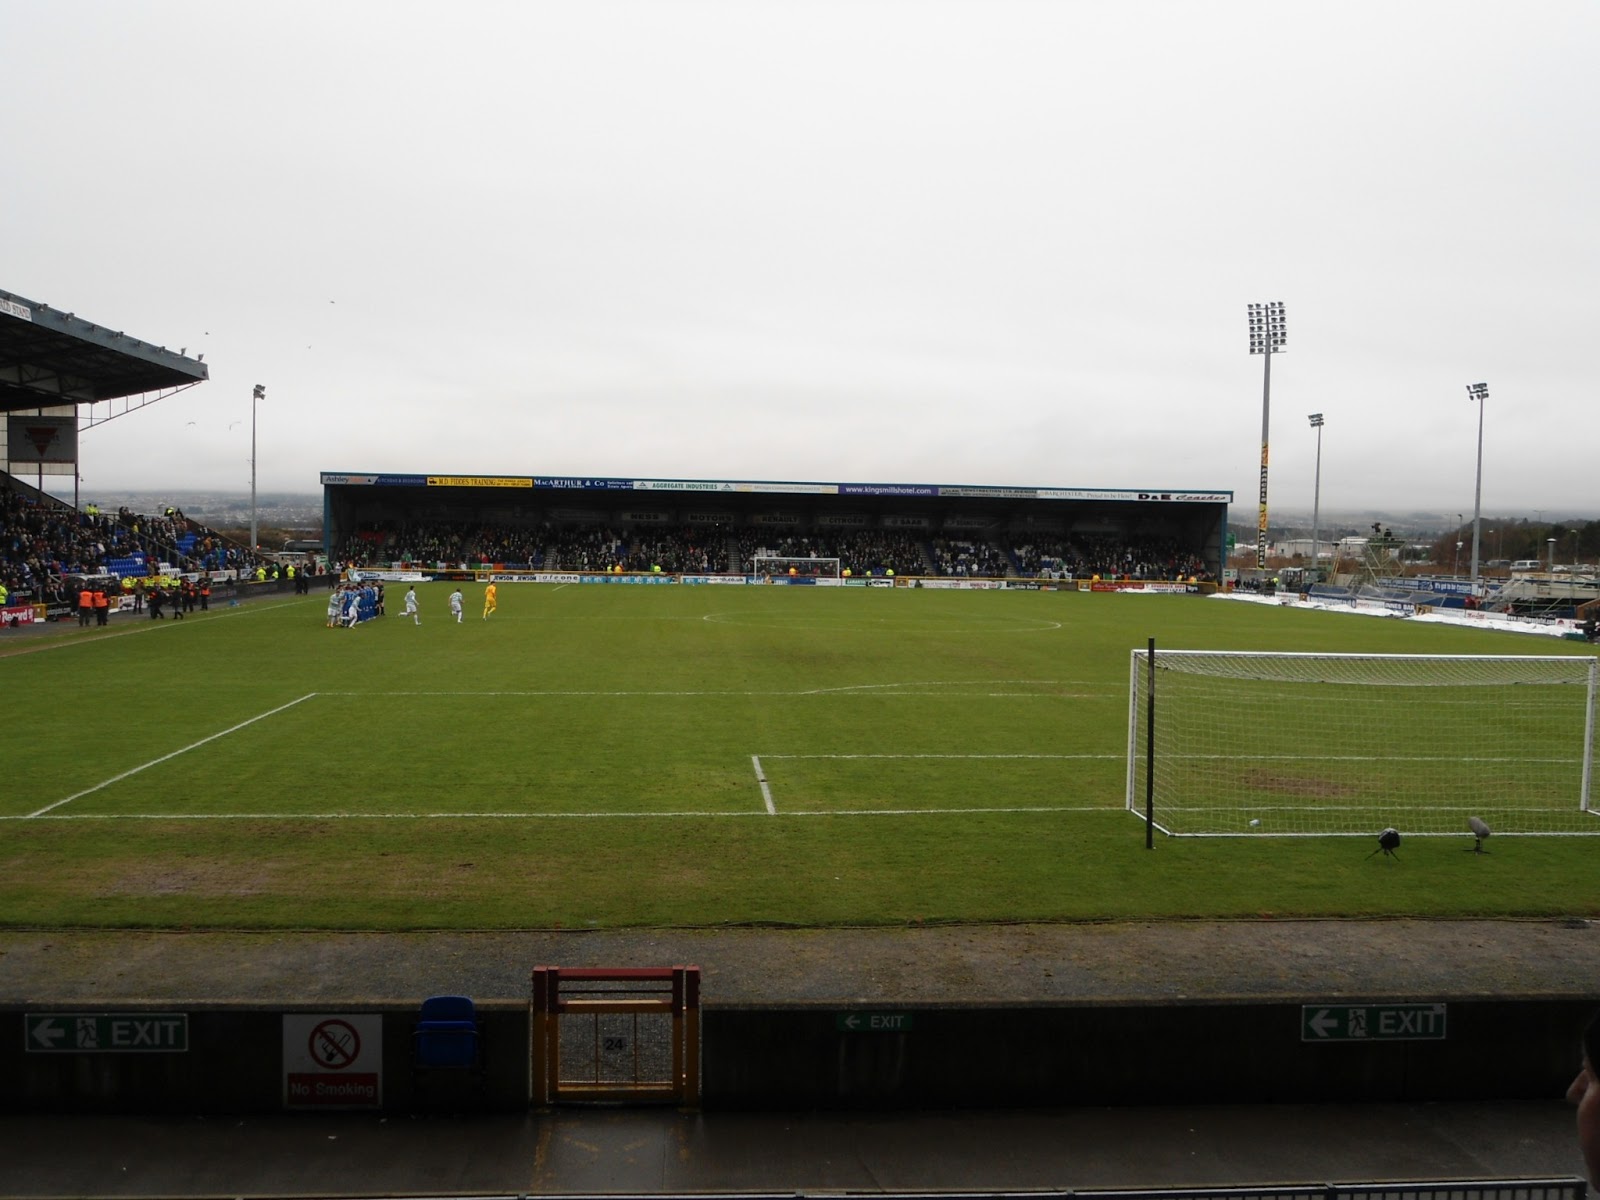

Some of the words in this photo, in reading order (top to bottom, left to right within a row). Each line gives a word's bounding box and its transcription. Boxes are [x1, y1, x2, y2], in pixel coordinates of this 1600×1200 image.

[325, 476, 349, 484] Ashley
[870, 1015, 904, 1028] EXIT
[1378, 1011, 1439, 1033] EXIT
[112, 1021, 181, 1045] EXIT
[605, 1039, 624, 1050] 24
[291, 1083, 310, 1096] No
[316, 1082, 374, 1097] Smoking
